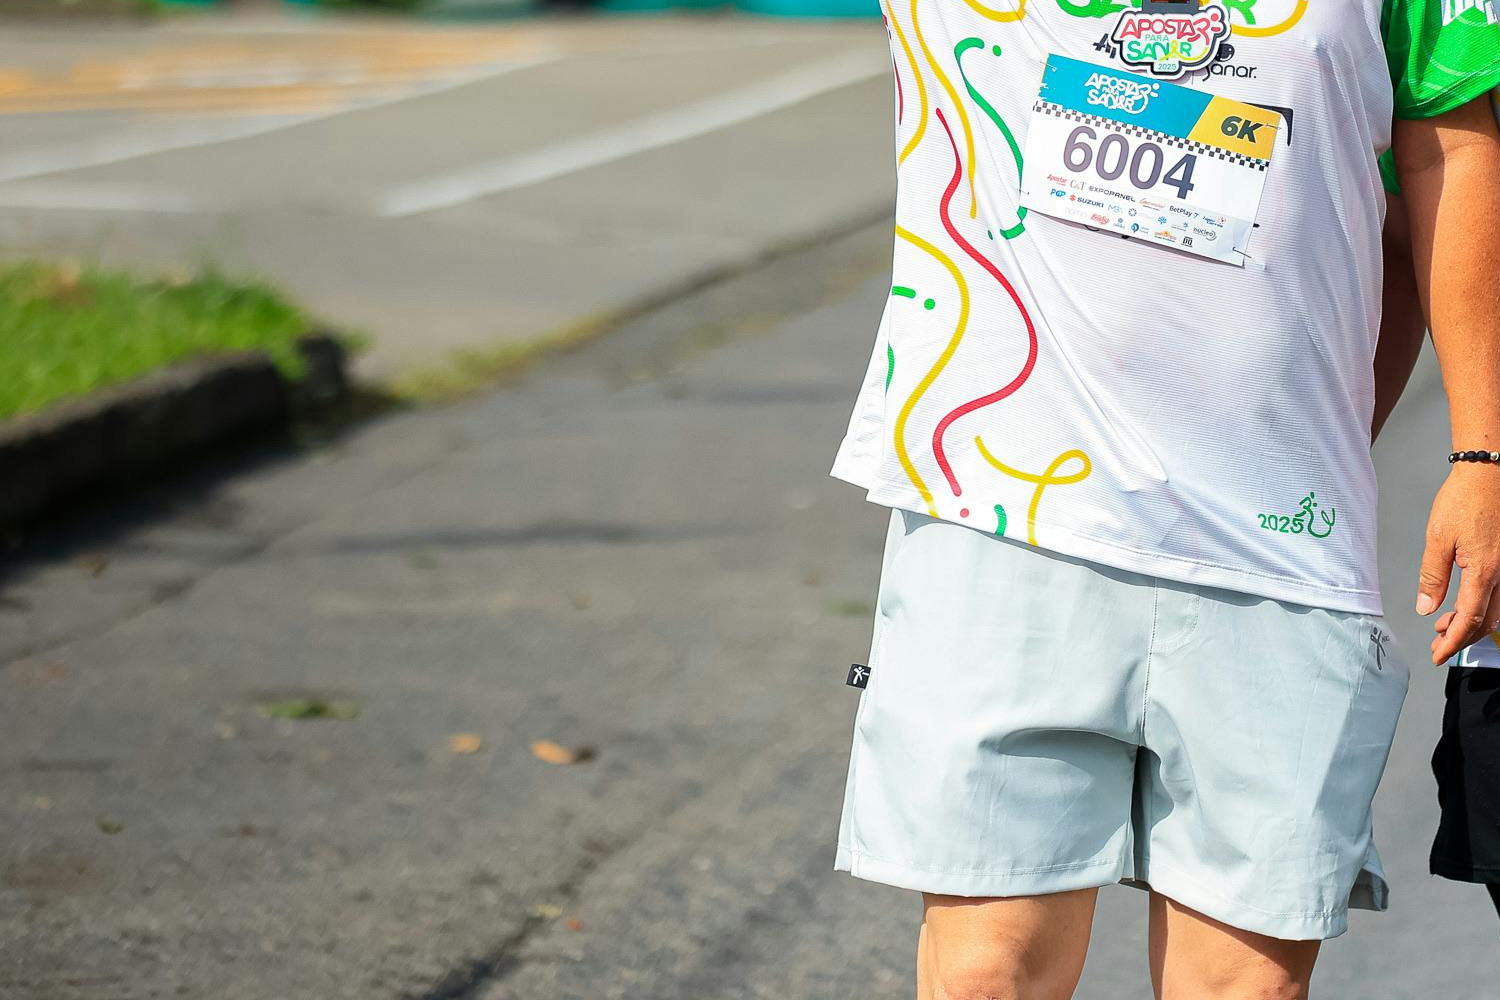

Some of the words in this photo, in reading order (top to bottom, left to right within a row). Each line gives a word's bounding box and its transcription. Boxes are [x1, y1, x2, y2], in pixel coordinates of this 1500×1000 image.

[1120, 17, 1212, 45] APOSTAR
[1145, 34, 1169, 42] PARA
[1158, 63, 1177, 71] 2025
[1084, 73, 1154, 100] APOSTAR
[1220, 115, 1263, 144] 6K
[1063, 126, 1198, 200] 6004
[1077, 197, 1105, 208] SUZUKI
[1088, 185, 1136, 202] EXPOPANEL
[1169, 205, 1193, 218] BetPlay
[1257, 513, 1304, 533] 2025
